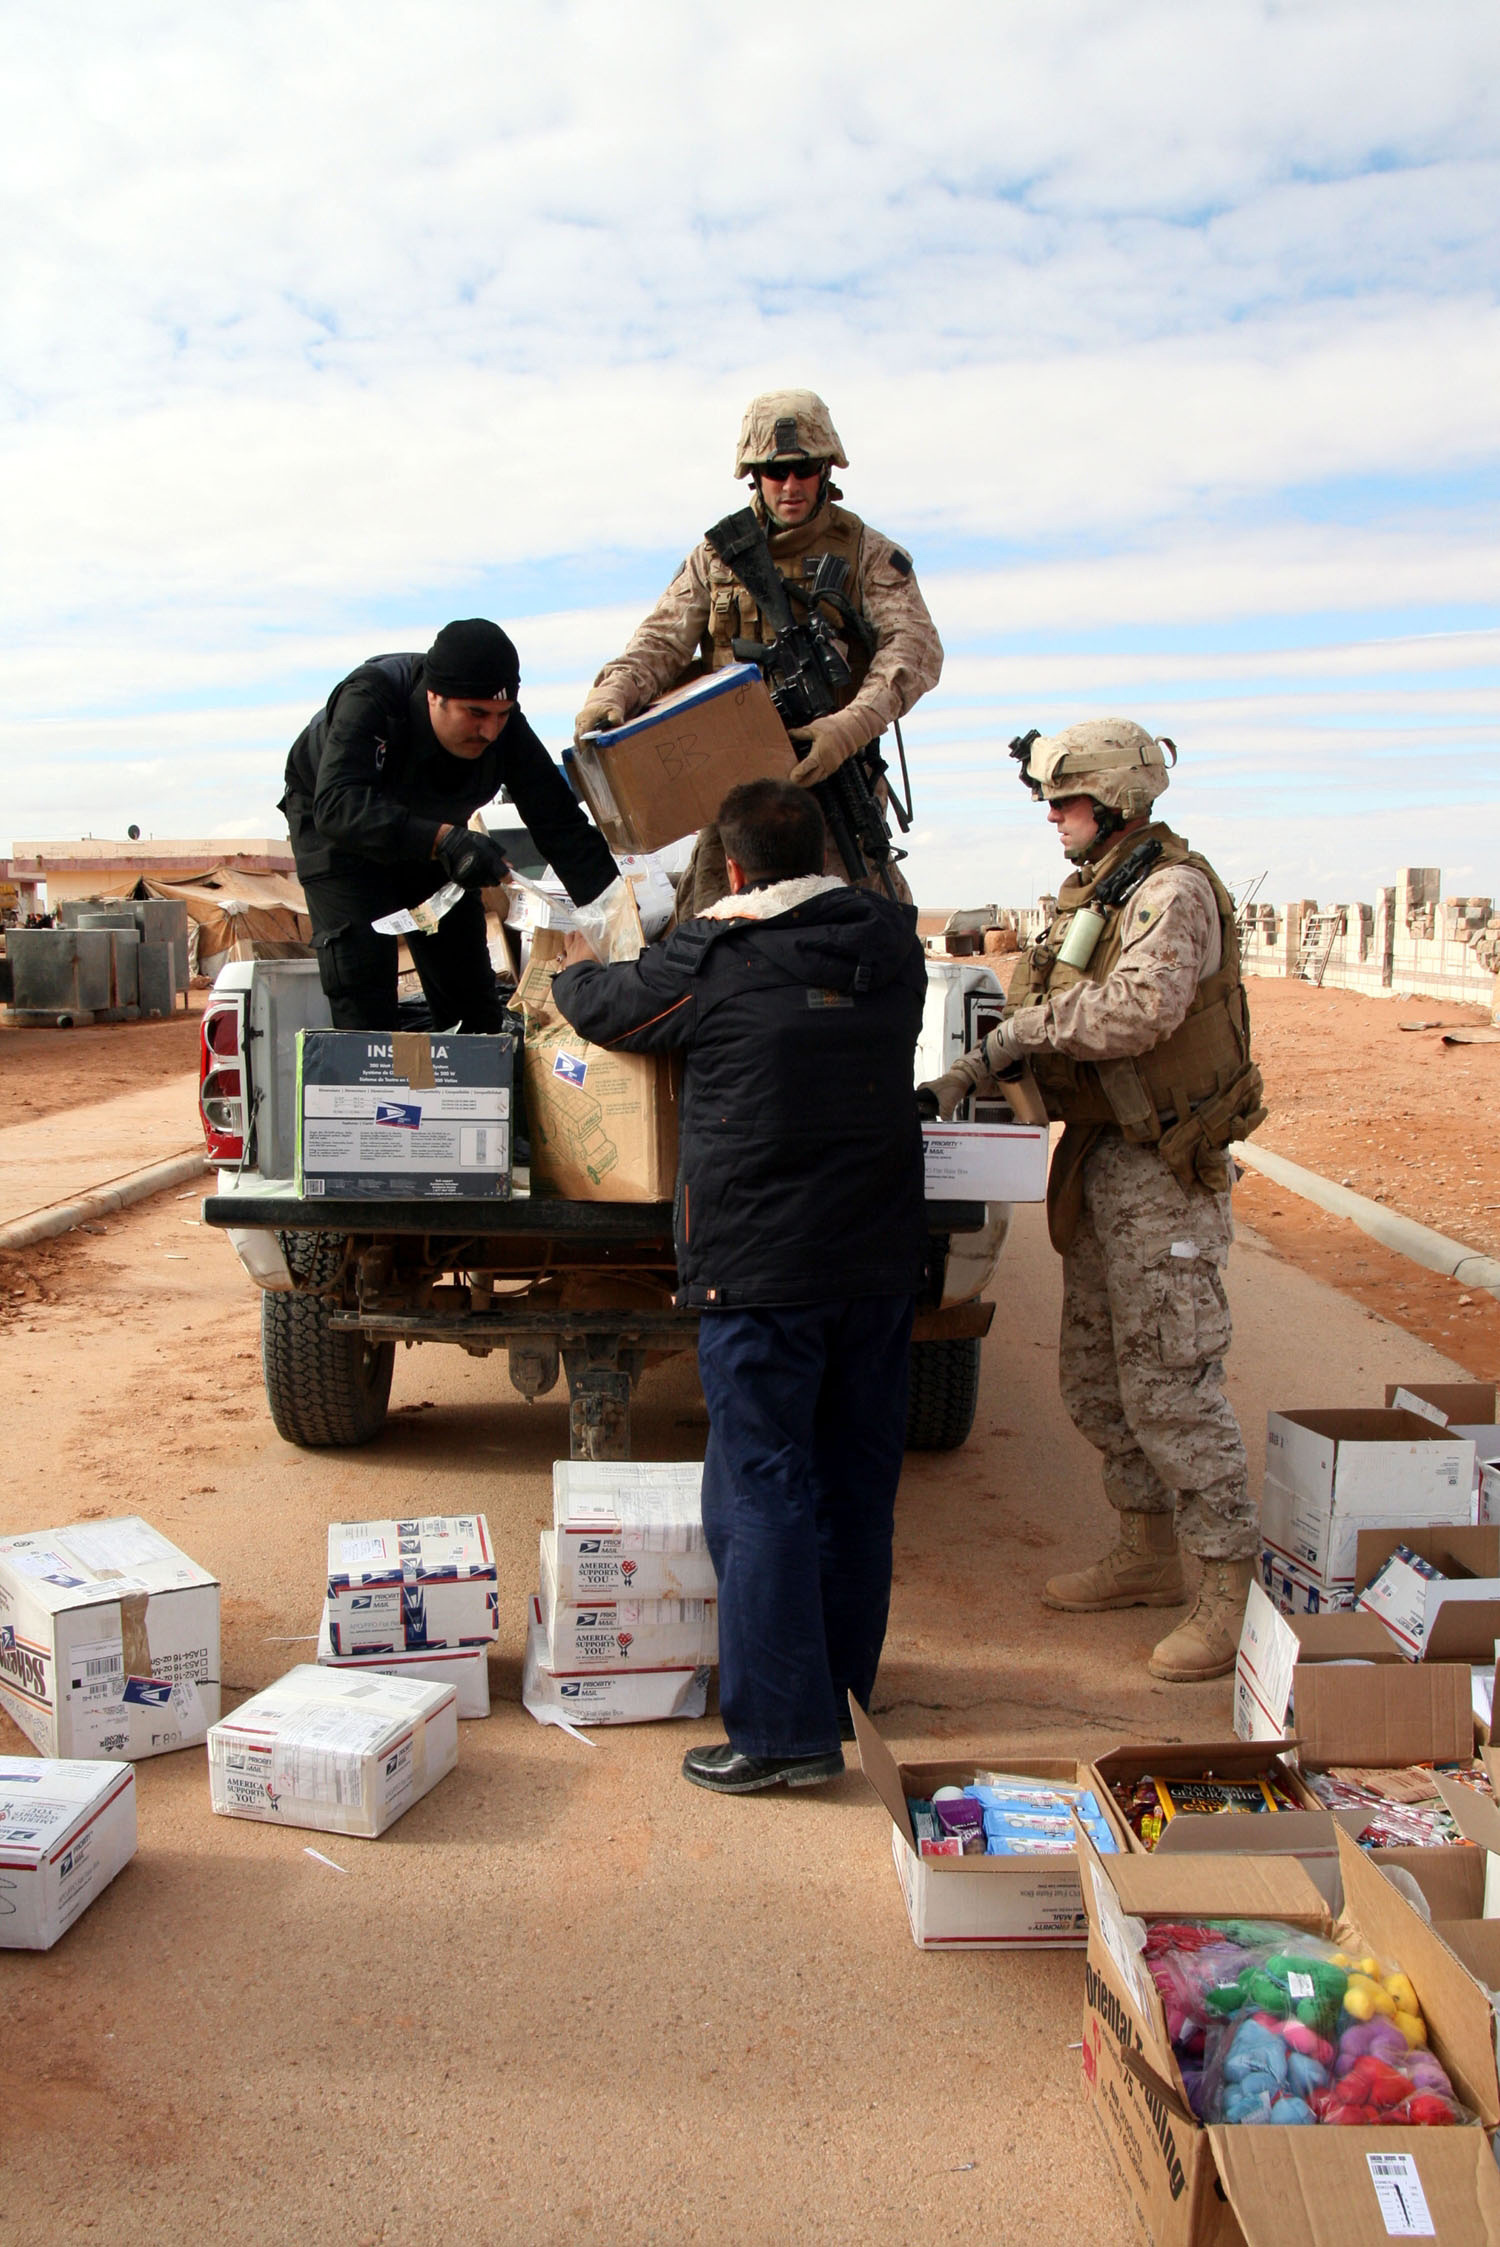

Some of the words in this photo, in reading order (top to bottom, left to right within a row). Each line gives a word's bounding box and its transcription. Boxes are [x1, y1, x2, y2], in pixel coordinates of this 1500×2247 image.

[367, 1044, 448, 1060] INSIA
[587, 1575, 609, 1583] YOU
[374, 1592, 400, 1600] PRIORIT
[584, 1647, 605, 1655] YOU
[582, 1680, 612, 1688] PRIORITY
[248, 1755, 272, 1765] PRIORIT
[227, 1778, 264, 1790] AMERICA
[227, 1785, 265, 1797] SUPPORTS
[1170, 1788, 1263, 1800] GEOGRAPHIC
[235, 1793, 256, 1804] YOU
[1086, 1961, 1132, 2049] Oriental
